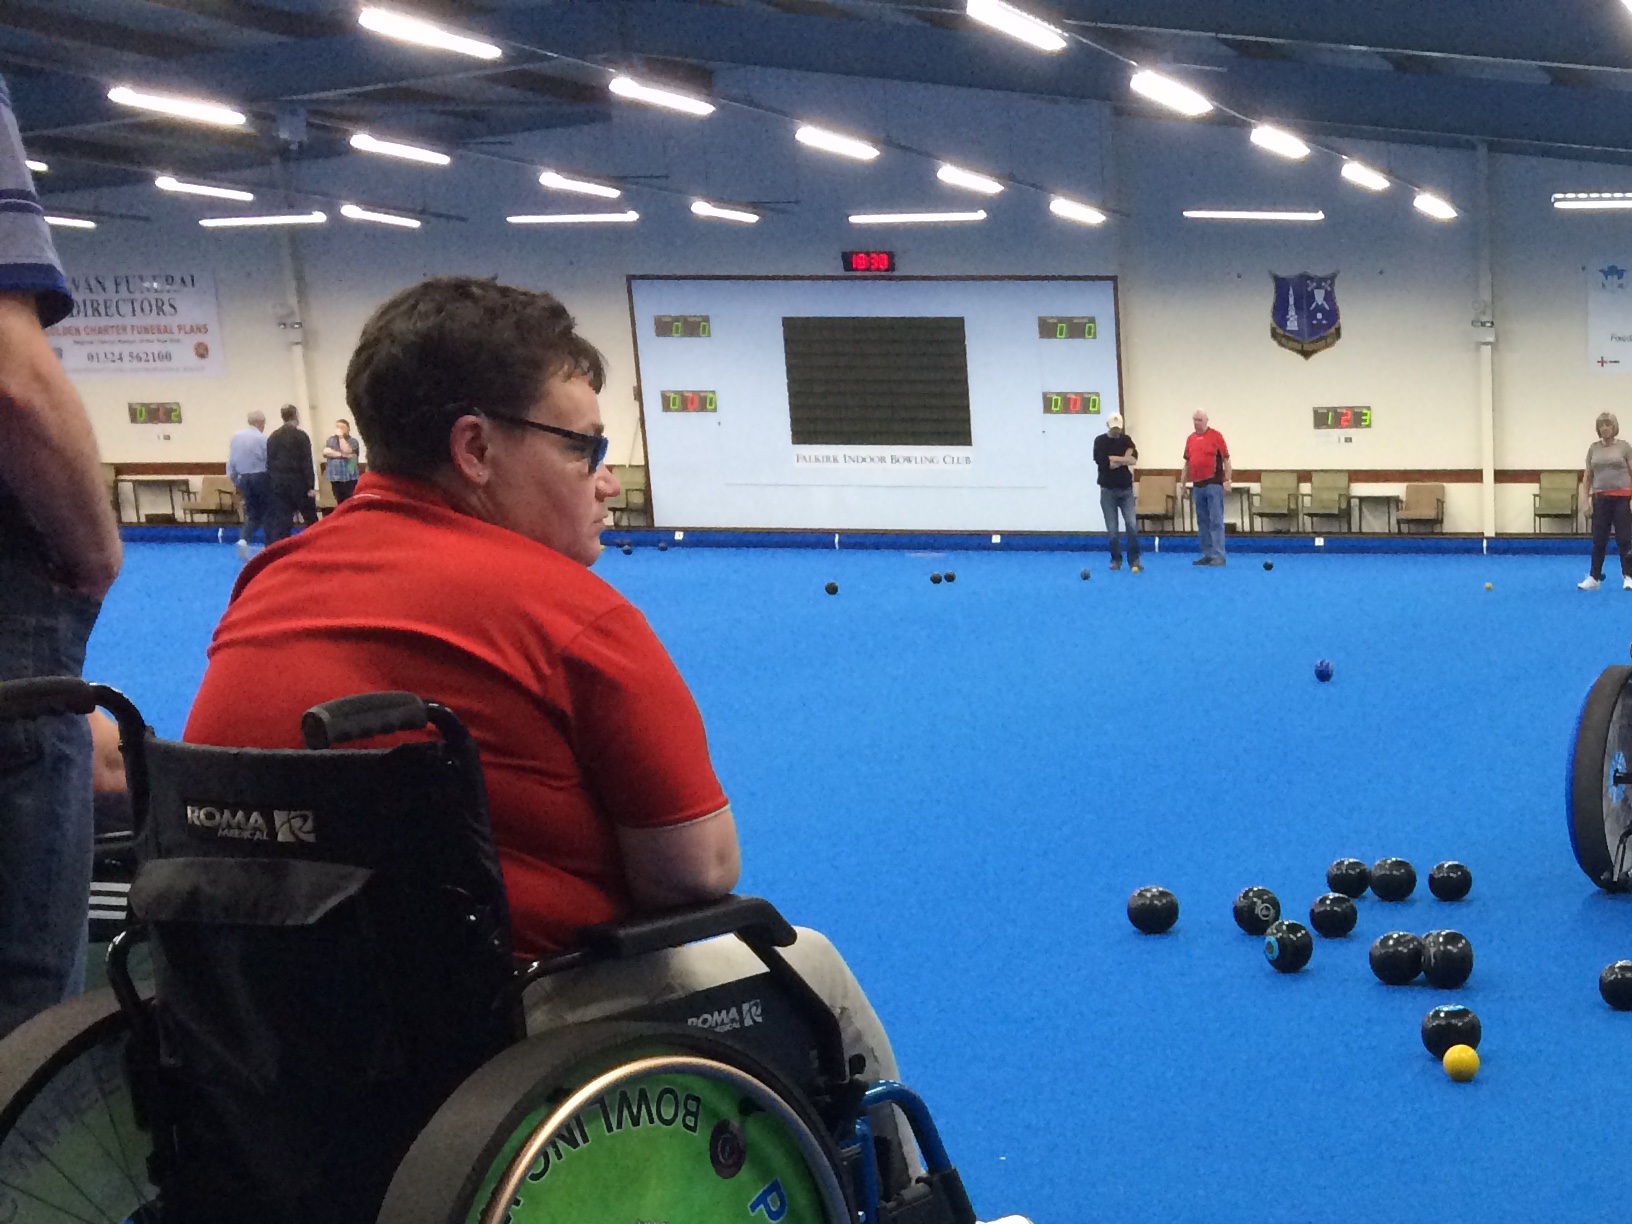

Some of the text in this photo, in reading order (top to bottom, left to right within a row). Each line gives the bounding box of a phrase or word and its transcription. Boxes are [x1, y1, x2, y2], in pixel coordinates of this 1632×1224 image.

[68, 297, 178, 318] DIRECTORS
[131, 324, 175, 335] FUNERAL
[177, 323, 209, 334] PLANS
[1340, 408, 1352, 427] 2
[1361, 408, 1371, 426] 3
[796, 453, 972, 465] FALKIRK INDOOR BOWLING CLUB
[186, 805, 268, 833] ROMA
